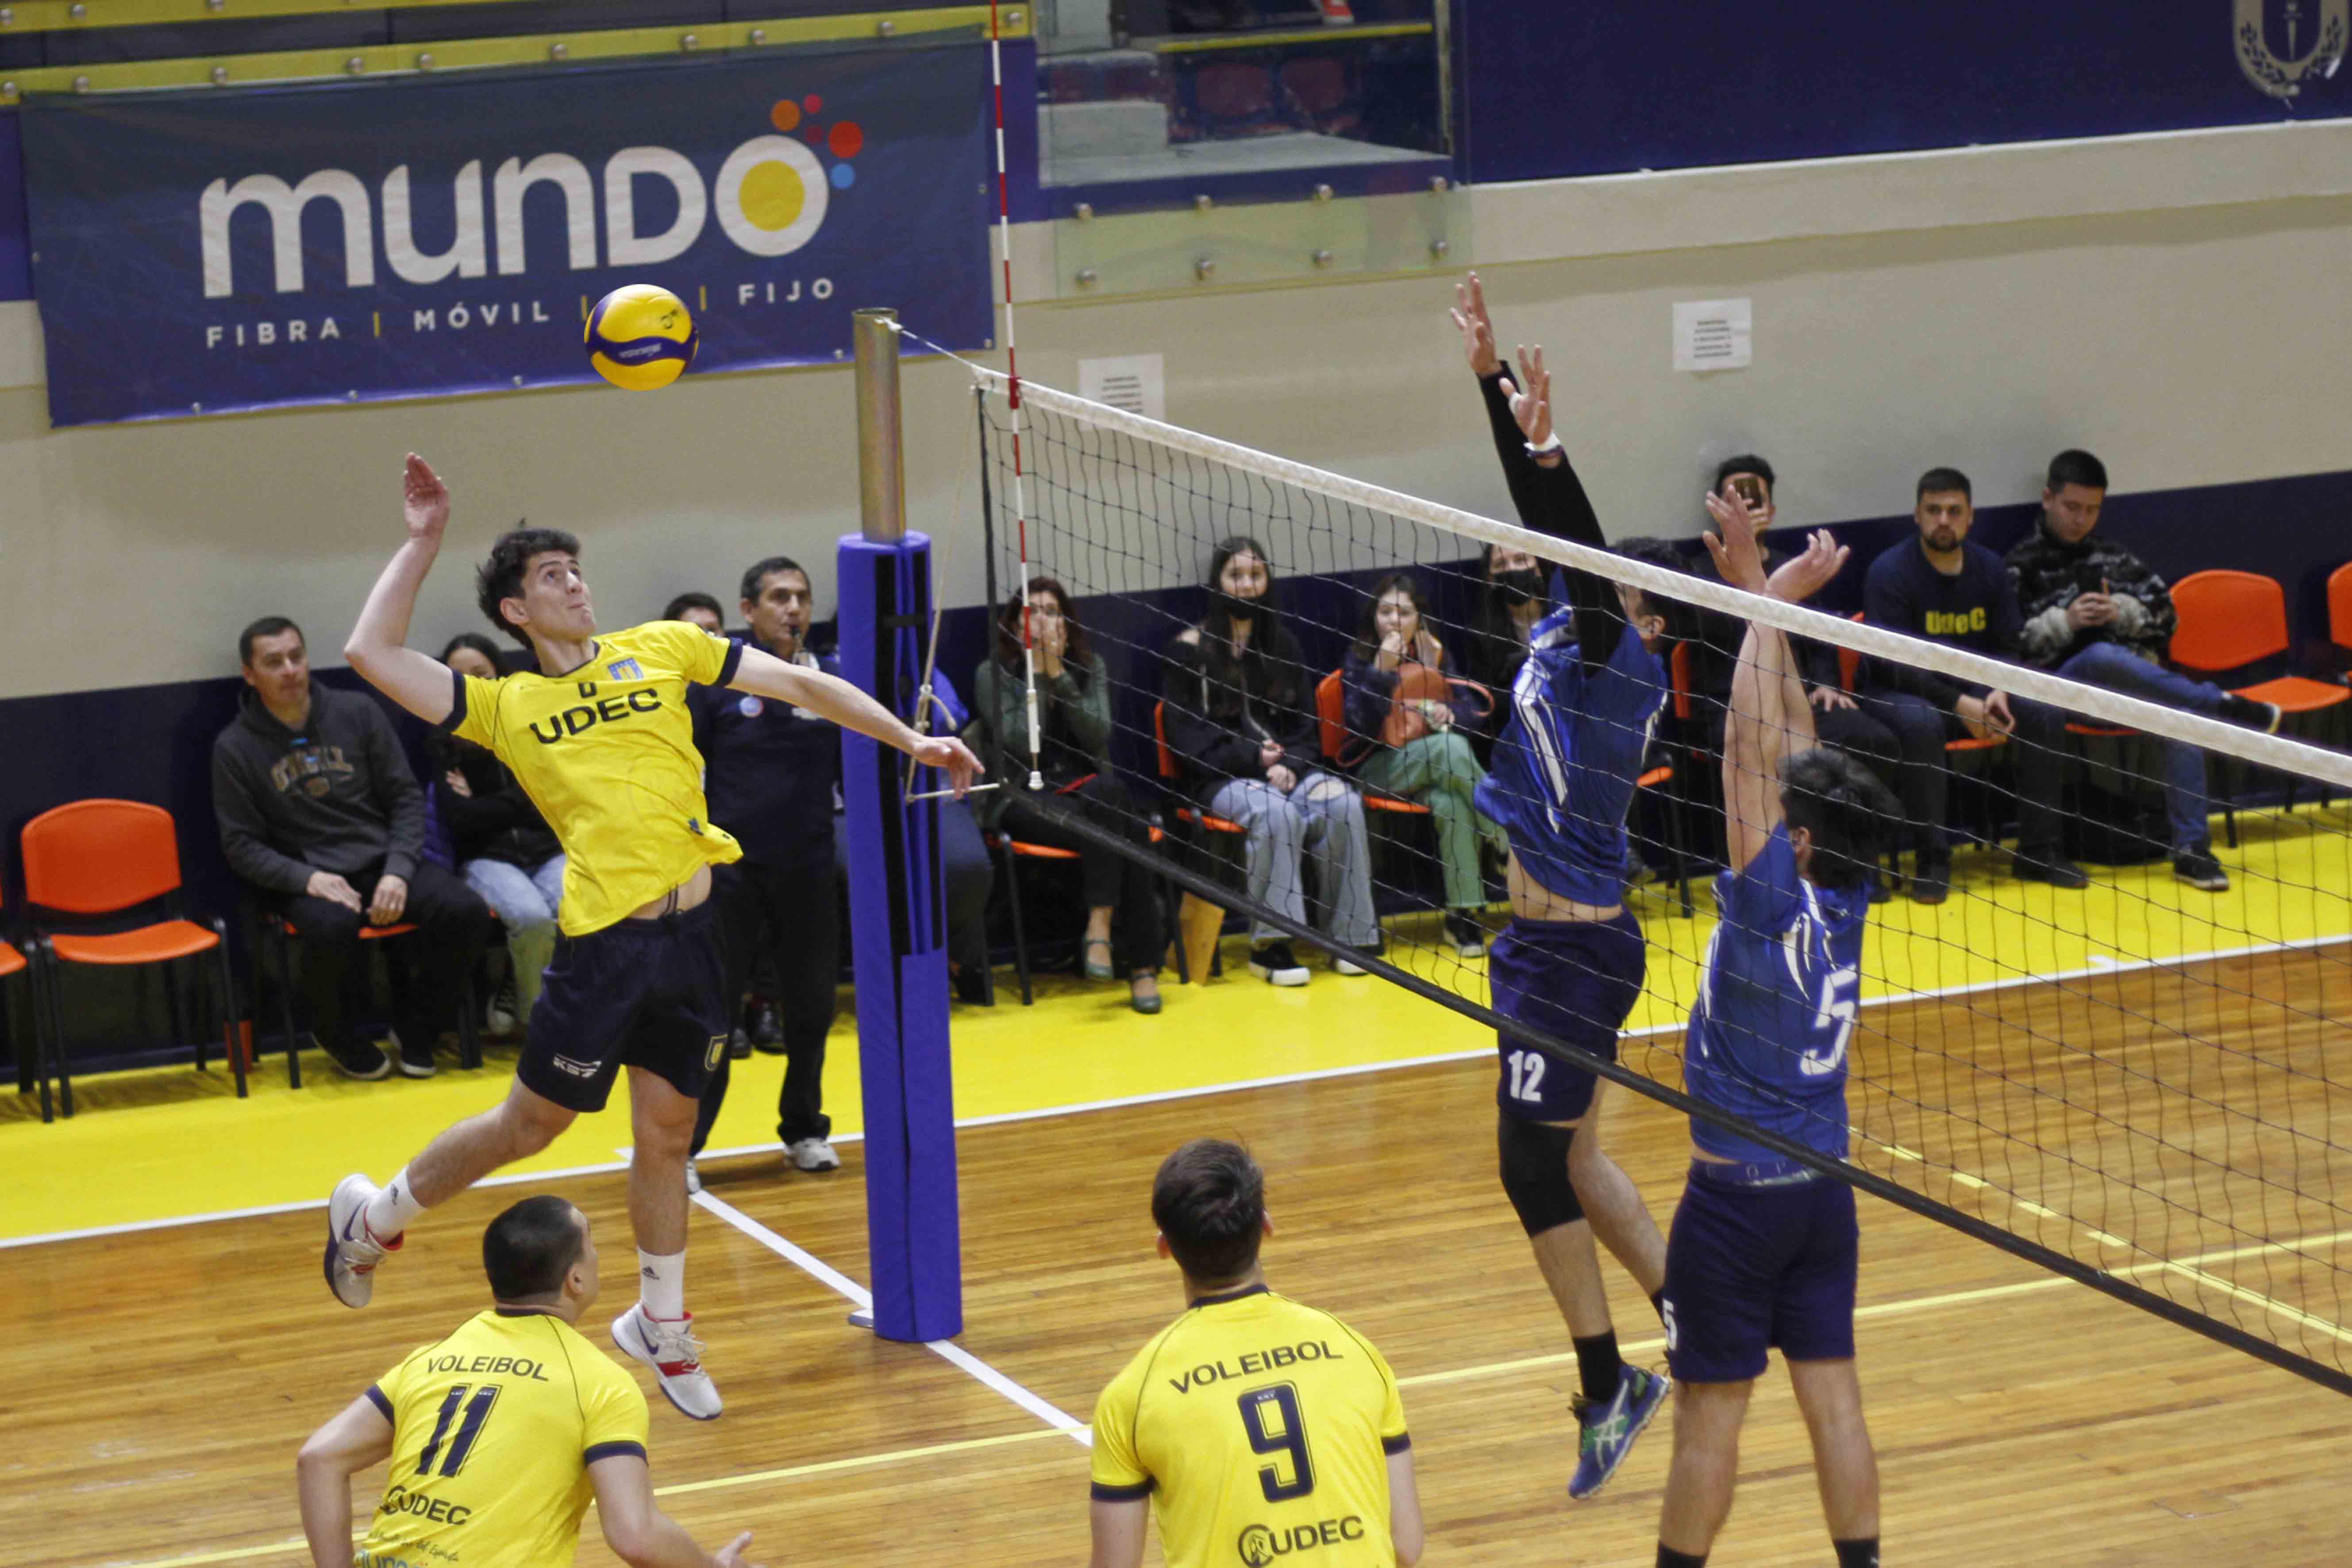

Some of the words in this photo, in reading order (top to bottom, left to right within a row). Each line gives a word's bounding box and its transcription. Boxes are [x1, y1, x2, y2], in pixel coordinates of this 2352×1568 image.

[206, 317, 340, 348] FIBRA
[414, 301, 549, 332] MÓVIL
[738, 278, 833, 305] FIJO
[529, 688, 662, 744] UDEC
[1800, 963, 1857, 1076] 5
[1508, 1050, 1546, 1102] 12
[1663, 1298, 1677, 1351] 5
[428, 1355, 548, 1382] VOLEIBOL
[1169, 1341, 1343, 1395] VOLEIBOL
[415, 1383, 502, 1477] 11
[1237, 1379, 1317, 1503] 9
